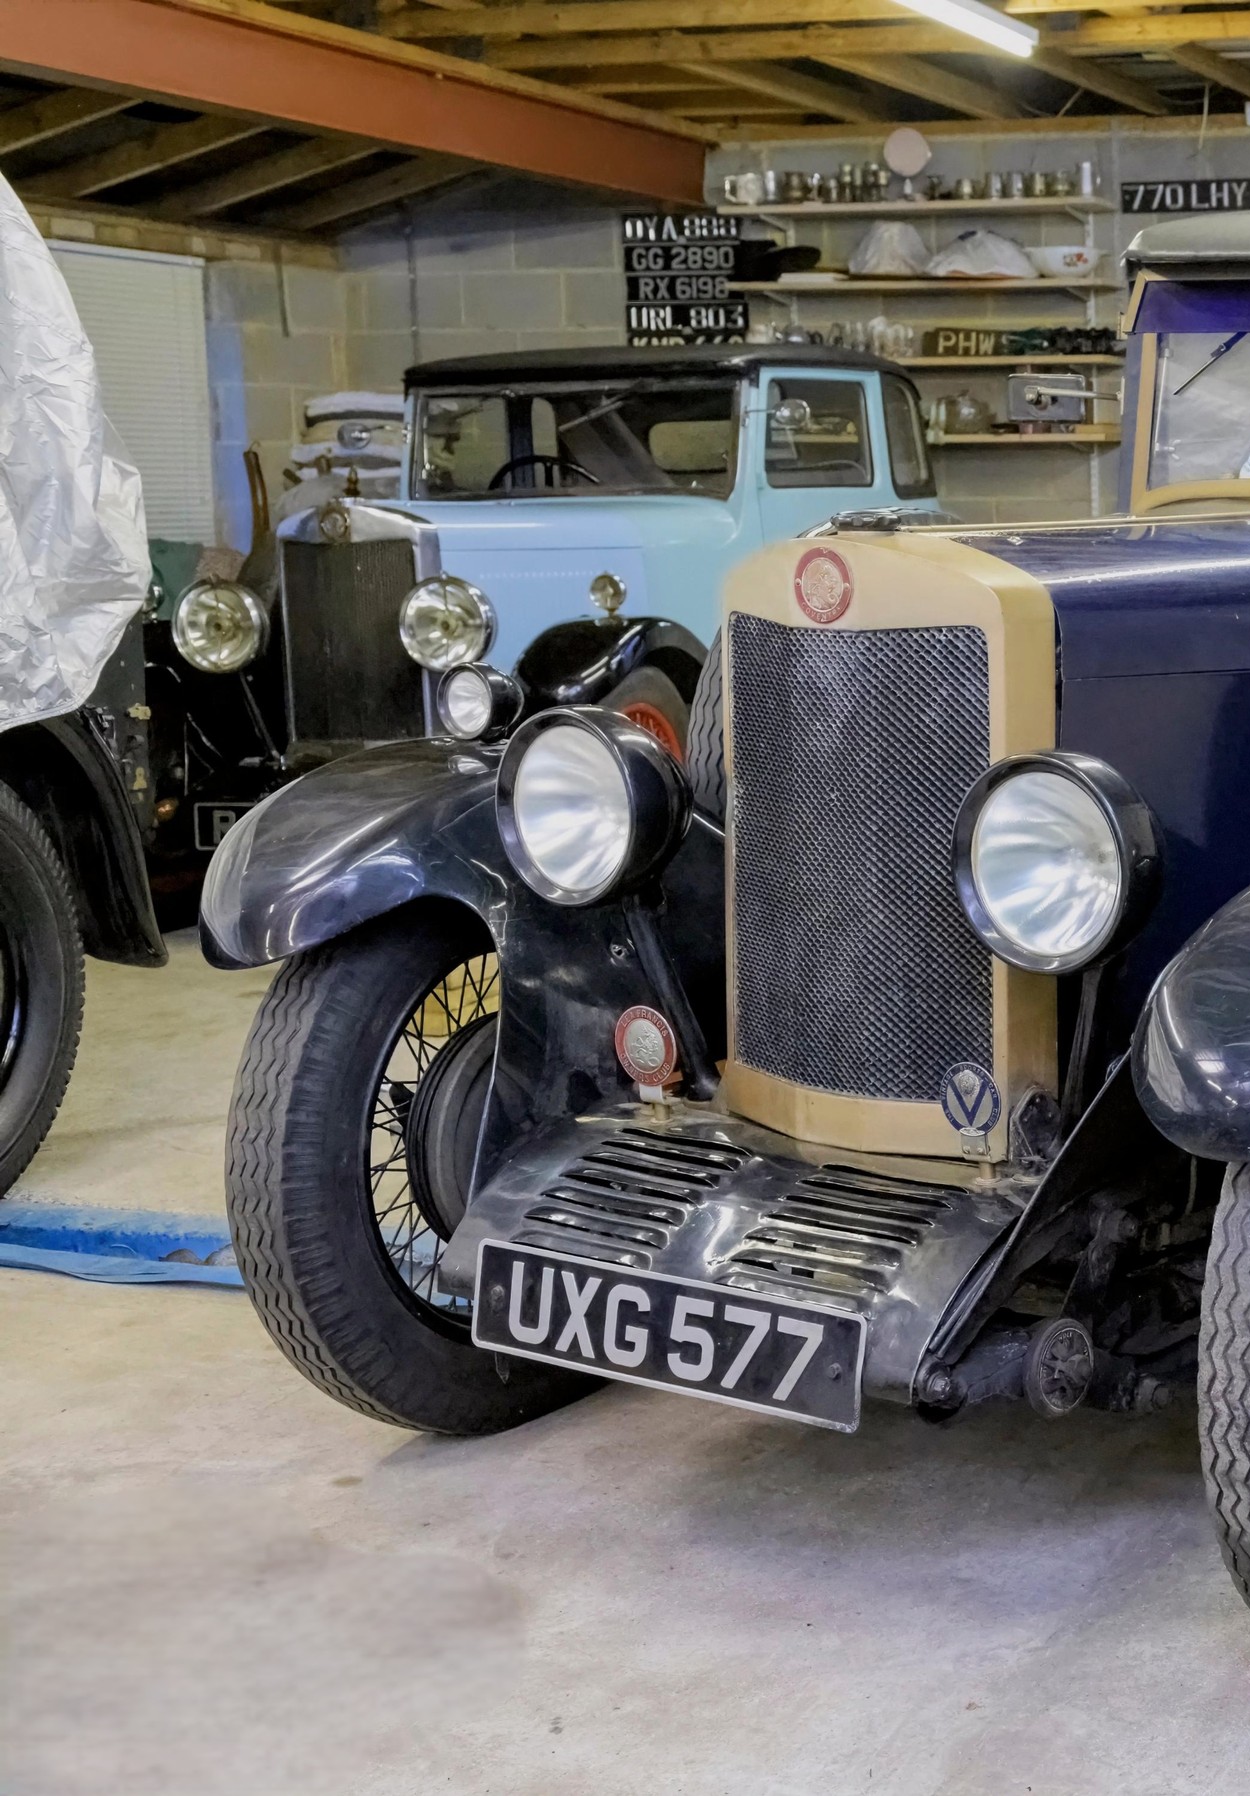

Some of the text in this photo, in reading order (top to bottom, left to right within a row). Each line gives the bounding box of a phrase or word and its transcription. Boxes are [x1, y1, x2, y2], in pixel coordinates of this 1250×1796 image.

[1121, 181, 1248, 211] 770 LHY
[631, 246, 735, 271] GG 2890
[638, 276, 730, 300] RX 6198
[689, 305, 744, 329] 803
[937, 330, 996, 356] PHW
[636, 1009, 669, 1037] FRANCIS
[652, 1062, 671, 1082] CLUB
[507, 1260, 825, 1402] UXG 577
